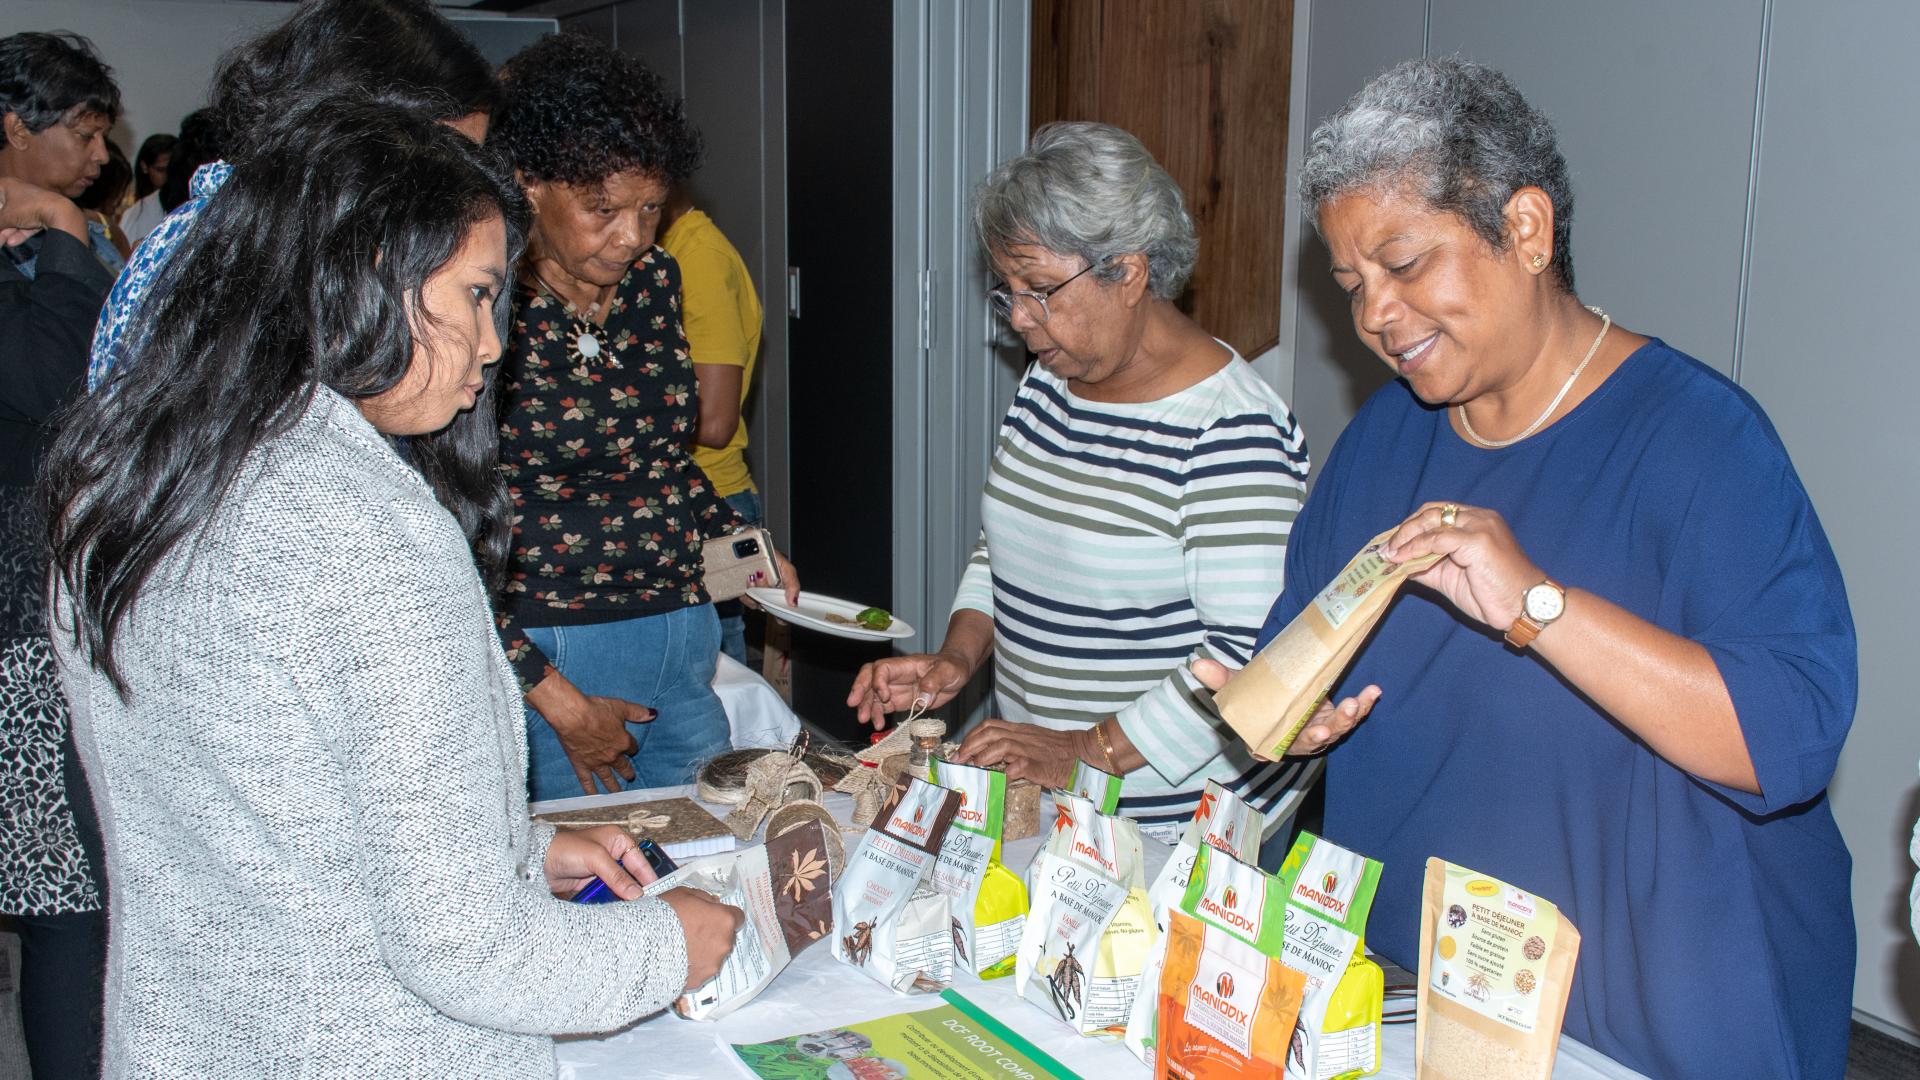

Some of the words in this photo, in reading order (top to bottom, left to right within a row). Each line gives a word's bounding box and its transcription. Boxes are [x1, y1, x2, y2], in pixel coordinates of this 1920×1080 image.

[868, 851, 886, 866] BASE
[885, 860, 895, 870] DE
[943, 856, 952, 866] DE
[952, 860, 979, 875] MANIOC
[1051, 865, 1083, 892] Petit
[1059, 892, 1075, 907] BASE
[1074, 902, 1082, 912] DE
[1296, 884, 1345, 914] MANIODIX
[1471, 903, 1491, 915] PETIT
[1201, 897, 1255, 934] MANIODIX
[1477, 914, 1491, 925] BASE
[1490, 920, 1499, 928] DE
[1499, 923, 1524, 937] MANIOC
[1300, 921, 1344, 958] Déjeuner
[1290, 945, 1303, 957] DE
[1302, 950, 1336, 973] MANIOC
[1193, 984, 1248, 1027] MANIODIX
[942, 1018, 971, 1034] DCF
[963, 1034, 1004, 1057] ROOT
